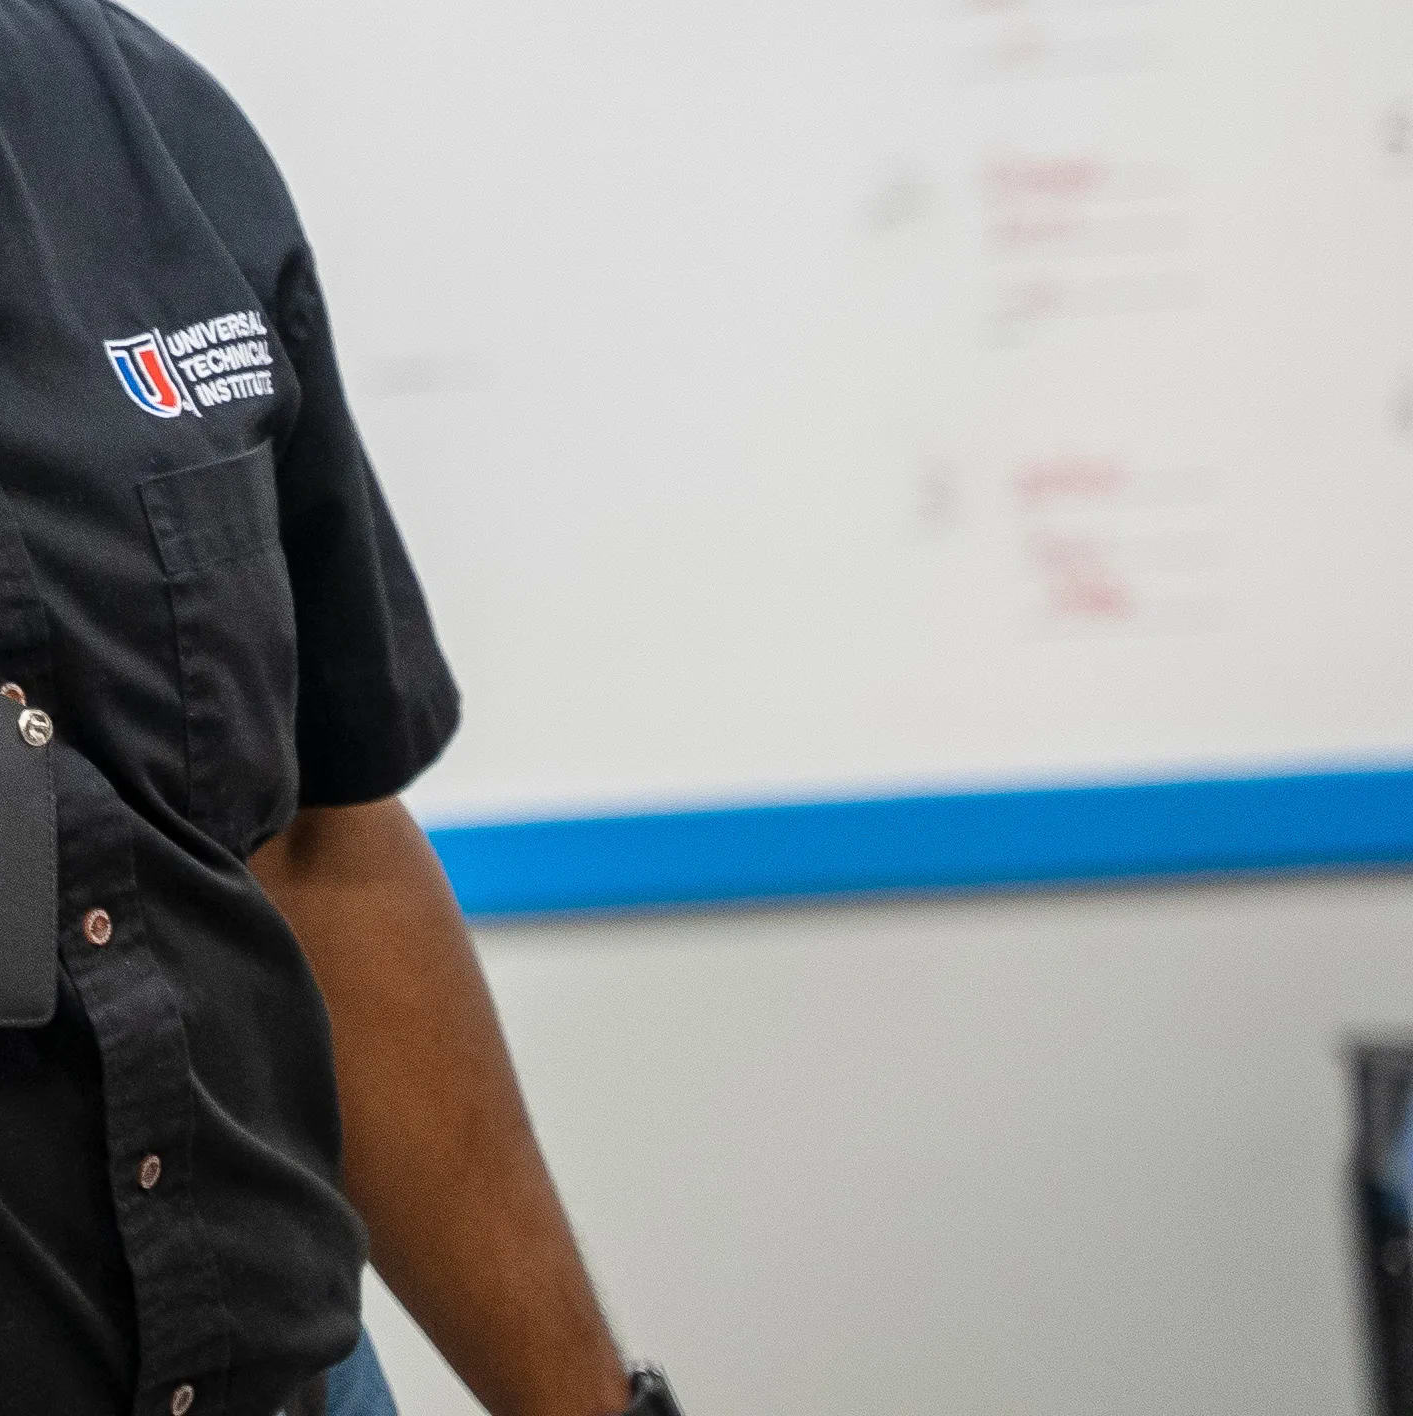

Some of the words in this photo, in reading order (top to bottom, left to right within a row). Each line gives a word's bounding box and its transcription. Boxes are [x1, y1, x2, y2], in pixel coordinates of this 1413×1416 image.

[166, 310, 267, 357] UNIVERSAL
[178, 340, 273, 381] TECHNICAL
[194, 370, 274, 406] INSTITUTE
